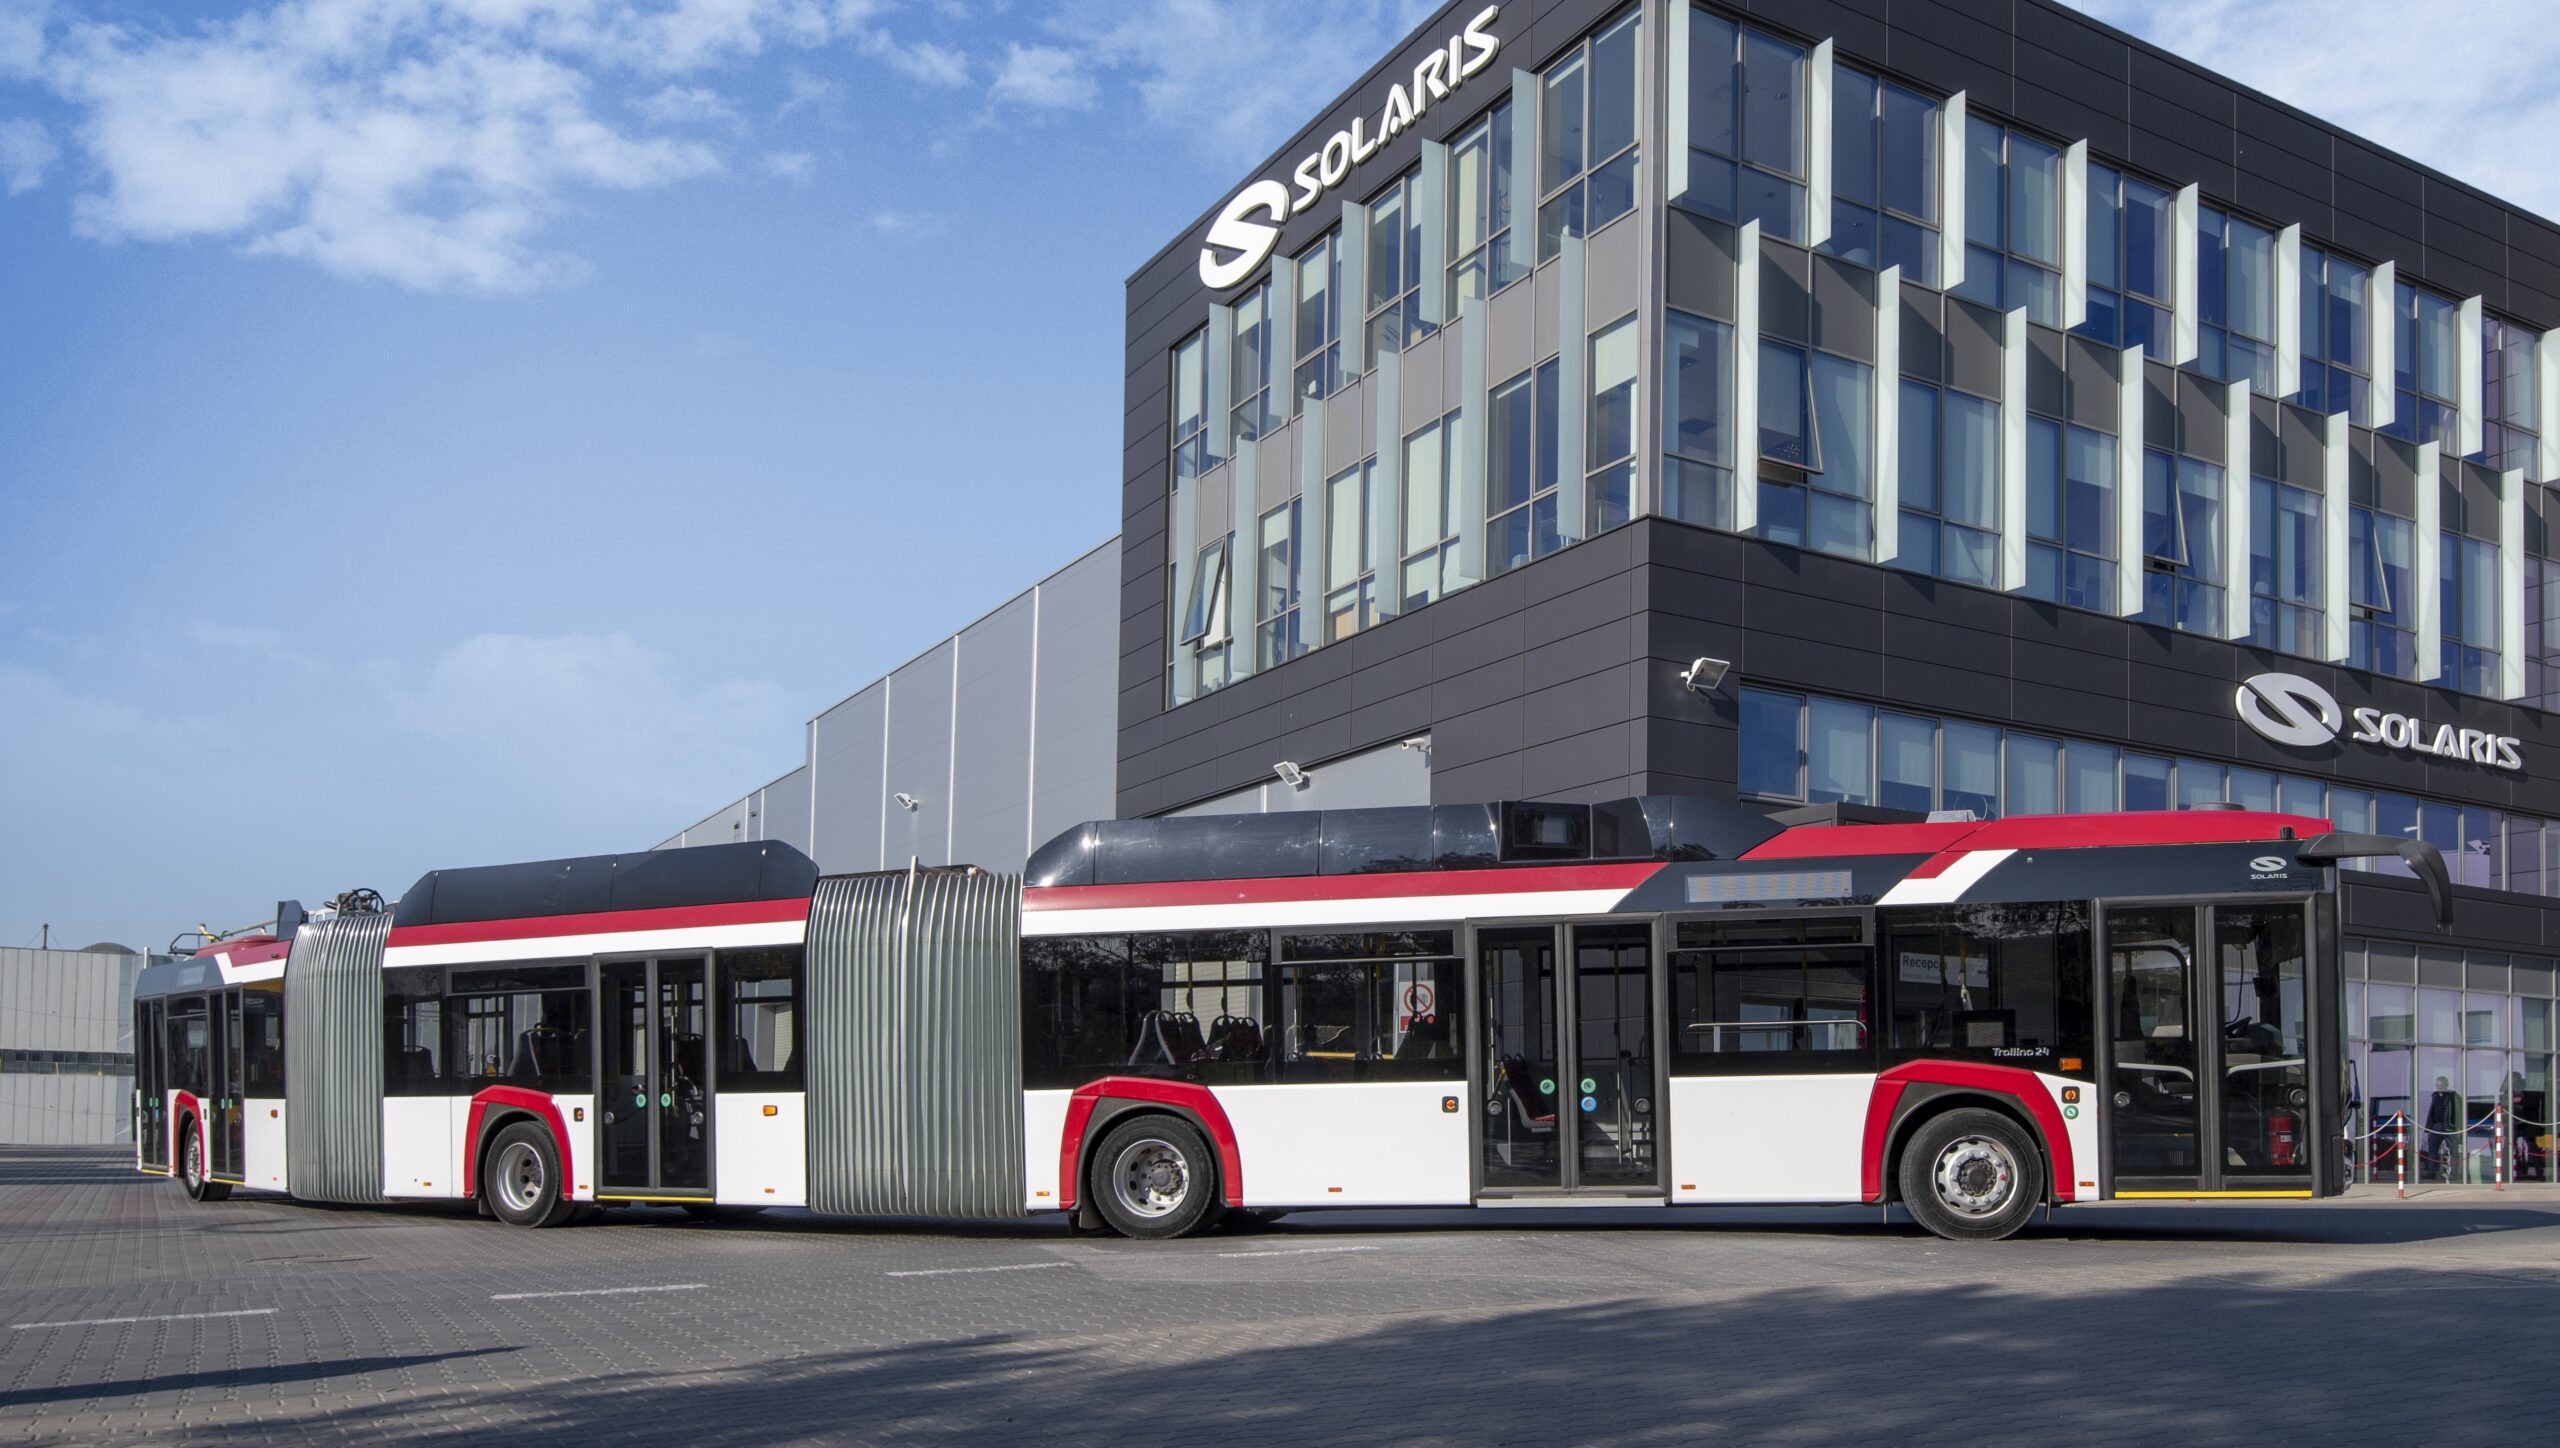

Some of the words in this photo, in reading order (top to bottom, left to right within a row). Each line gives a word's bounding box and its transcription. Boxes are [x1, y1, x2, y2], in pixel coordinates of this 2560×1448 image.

[1292, 4, 1500, 213] SOLARIS
[2352, 707, 2522, 770] SOLARIS
[1992, 1046, 2034, 1057] Trollino
[2035, 1046, 2050, 1057] 24
